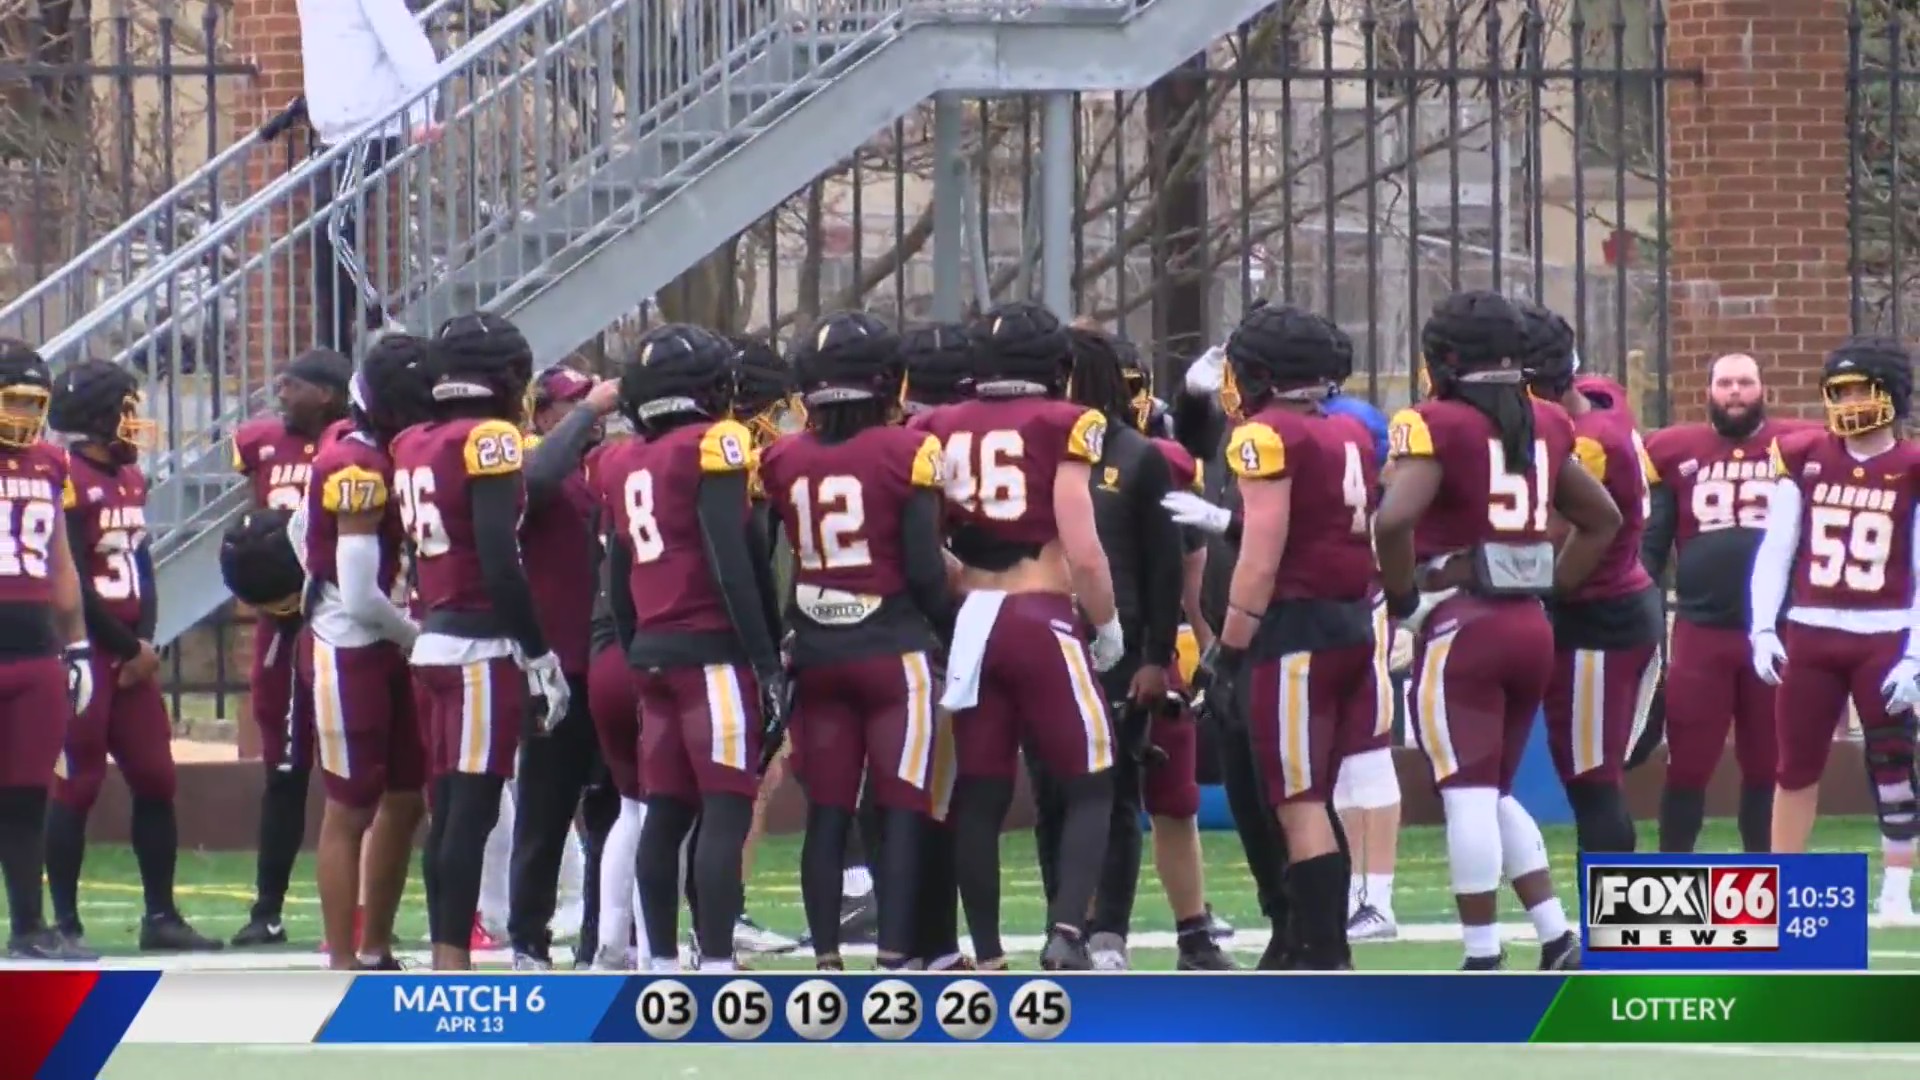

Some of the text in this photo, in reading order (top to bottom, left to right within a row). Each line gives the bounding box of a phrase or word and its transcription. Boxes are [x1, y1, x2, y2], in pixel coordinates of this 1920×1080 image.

[336, 478, 378, 511] 17
[719, 432, 745, 469] 8
[944, 429, 1027, 521] 46
[1239, 438, 1260, 471] 4
[1342, 440, 1368, 534] 4
[1487, 438, 1549, 531] 51
[623, 468, 665, 564] 8
[789, 474, 873, 570] 12
[1809, 506, 1894, 592] 59
